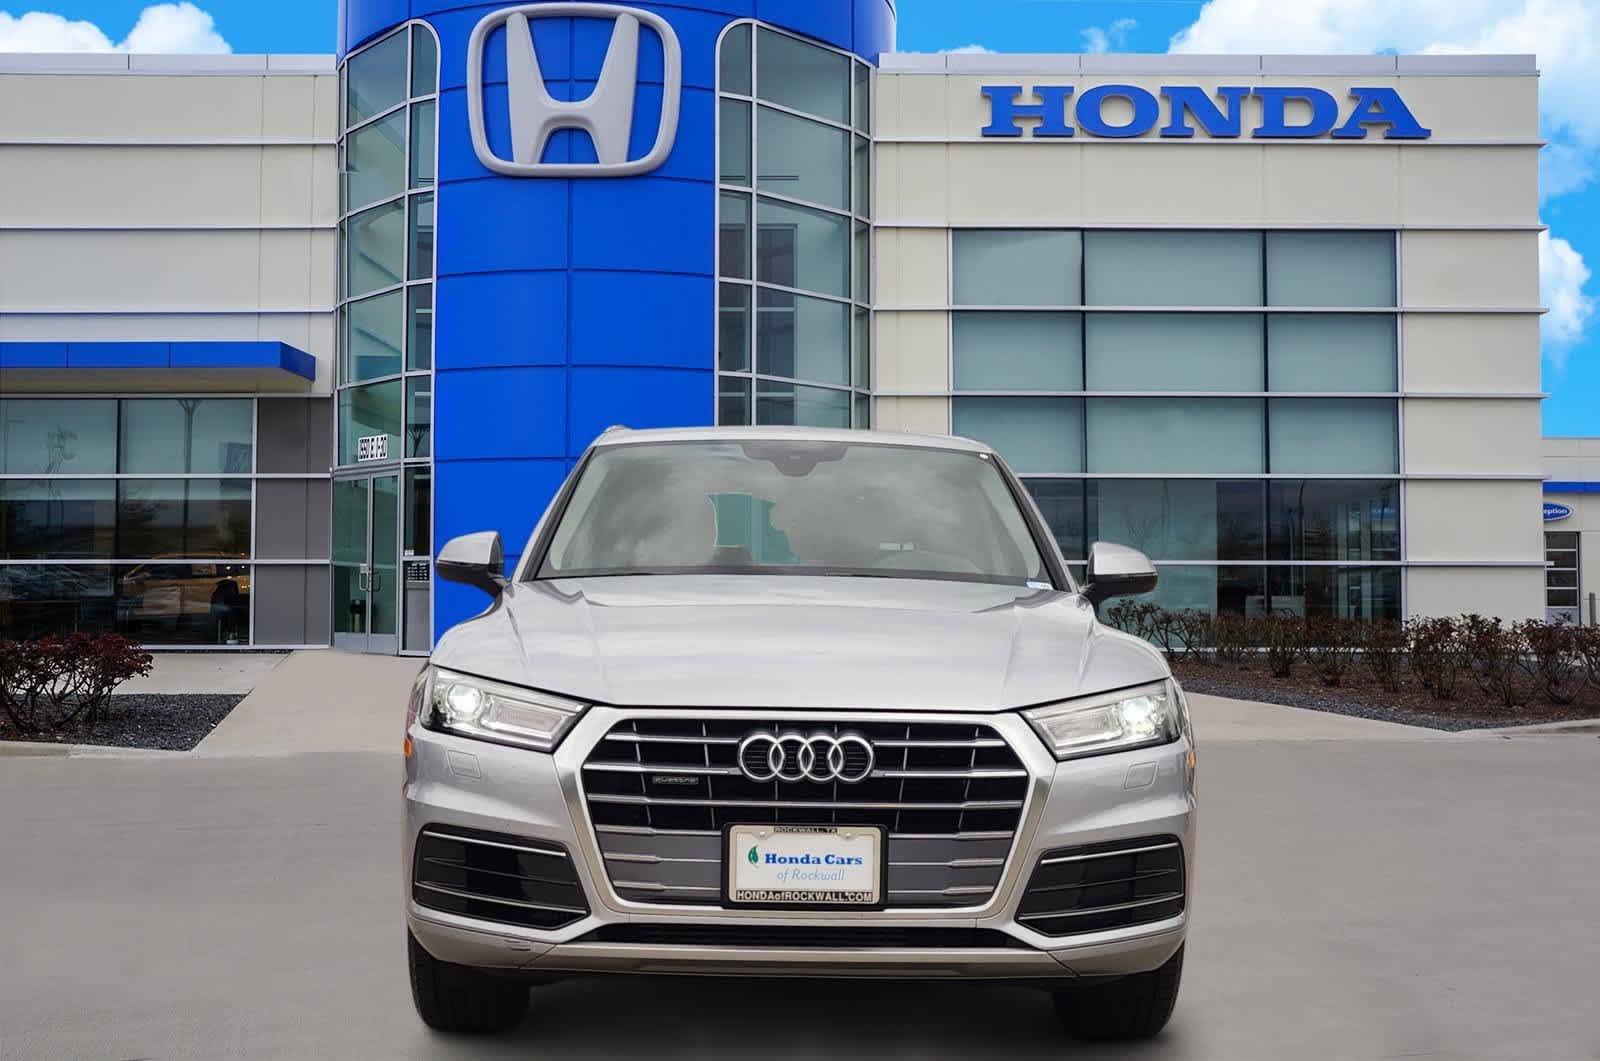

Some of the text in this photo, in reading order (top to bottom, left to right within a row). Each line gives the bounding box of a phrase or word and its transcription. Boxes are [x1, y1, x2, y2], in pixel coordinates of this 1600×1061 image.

[981, 84, 1431, 139] HONDA
[765, 853, 863, 865] Honda Cars
[777, 868, 845, 883] of Rockwall
